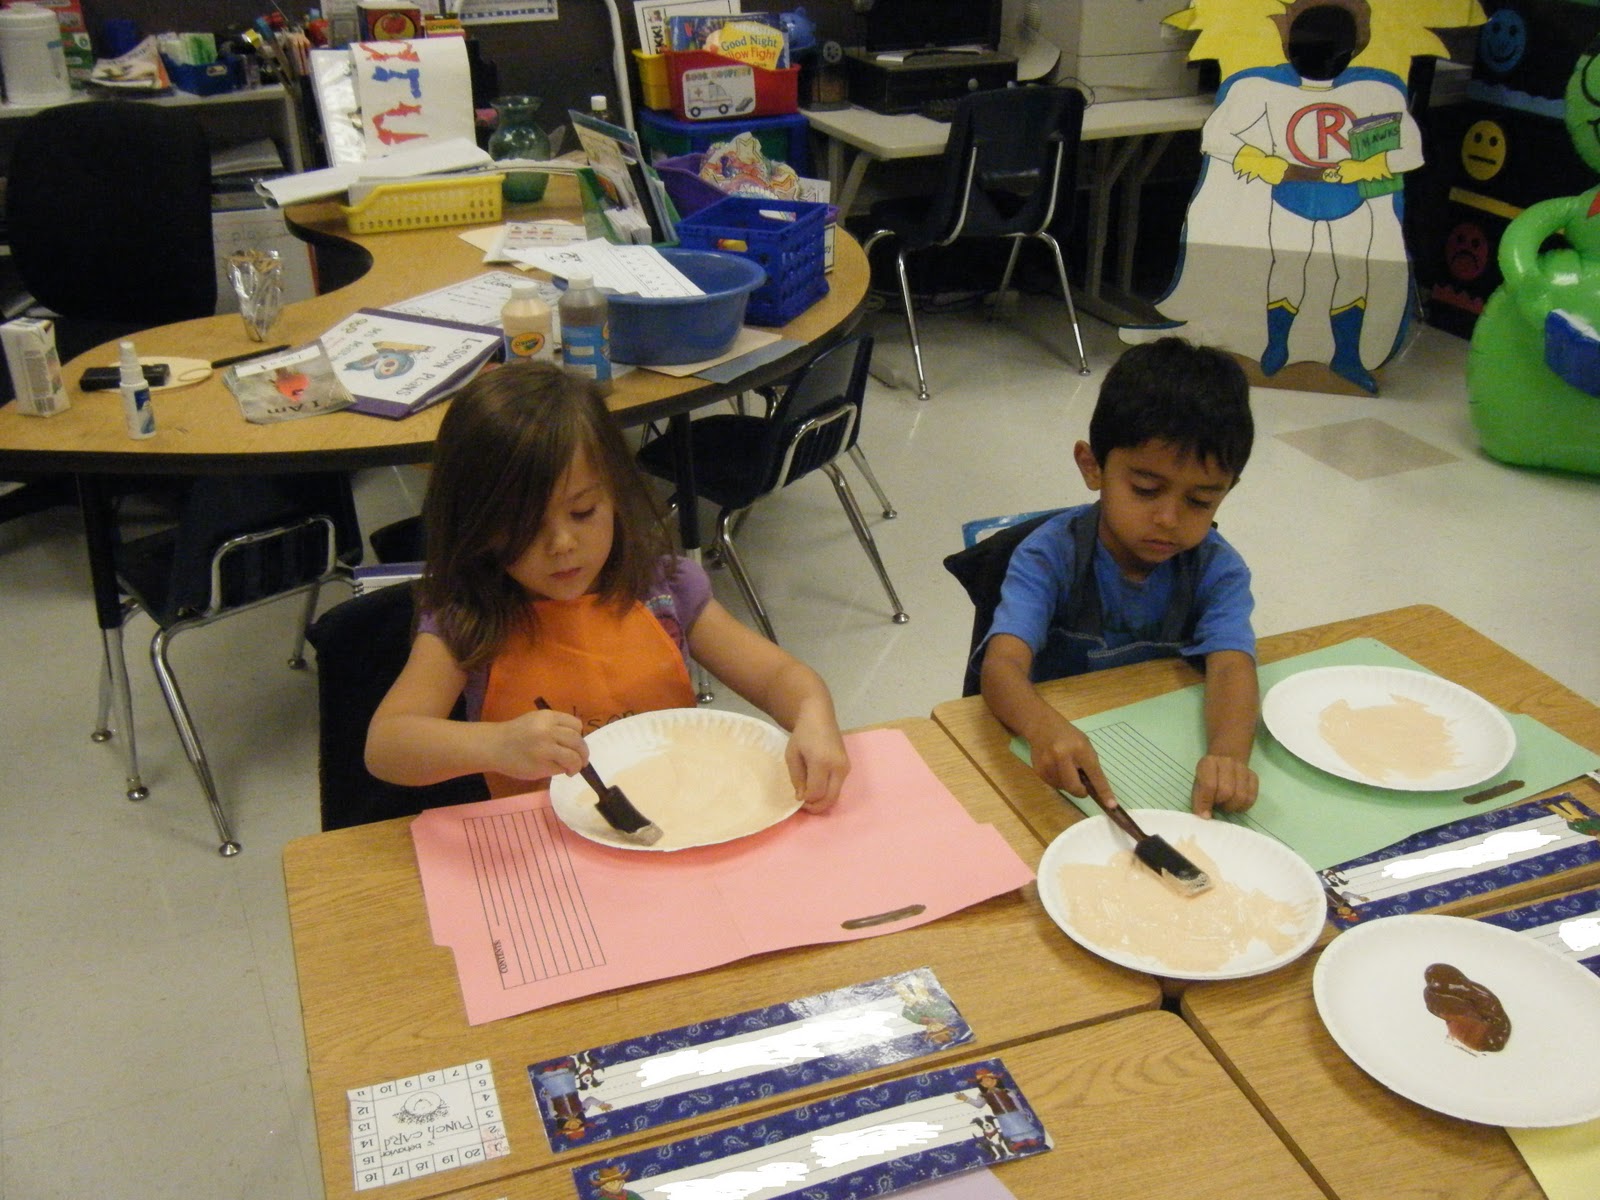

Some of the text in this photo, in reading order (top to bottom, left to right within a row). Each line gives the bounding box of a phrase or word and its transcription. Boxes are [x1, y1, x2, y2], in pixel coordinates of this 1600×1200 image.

[721, 35, 777, 52] Good Night
[751, 47, 776, 60] Fight
[267, 400, 320, 414] I Am
[428, 1075, 436, 1083] 8
[380, 1085, 392, 1093] 10
[482, 1093, 491, 1102] 4
[357, 1106, 369, 1115] 12
[358, 1122, 371, 1131] 13
[360, 1139, 373, 1148] 14
[380, 1142, 422, 1158] behavior
[464, 1148, 481, 1159] 20
[362, 1156, 375, 1165] 15
[442, 1154, 454, 1164] 19
[392, 1166, 404, 1176] 17
[416, 1161, 429, 1171] 18
[364, 1172, 377, 1182] 16
